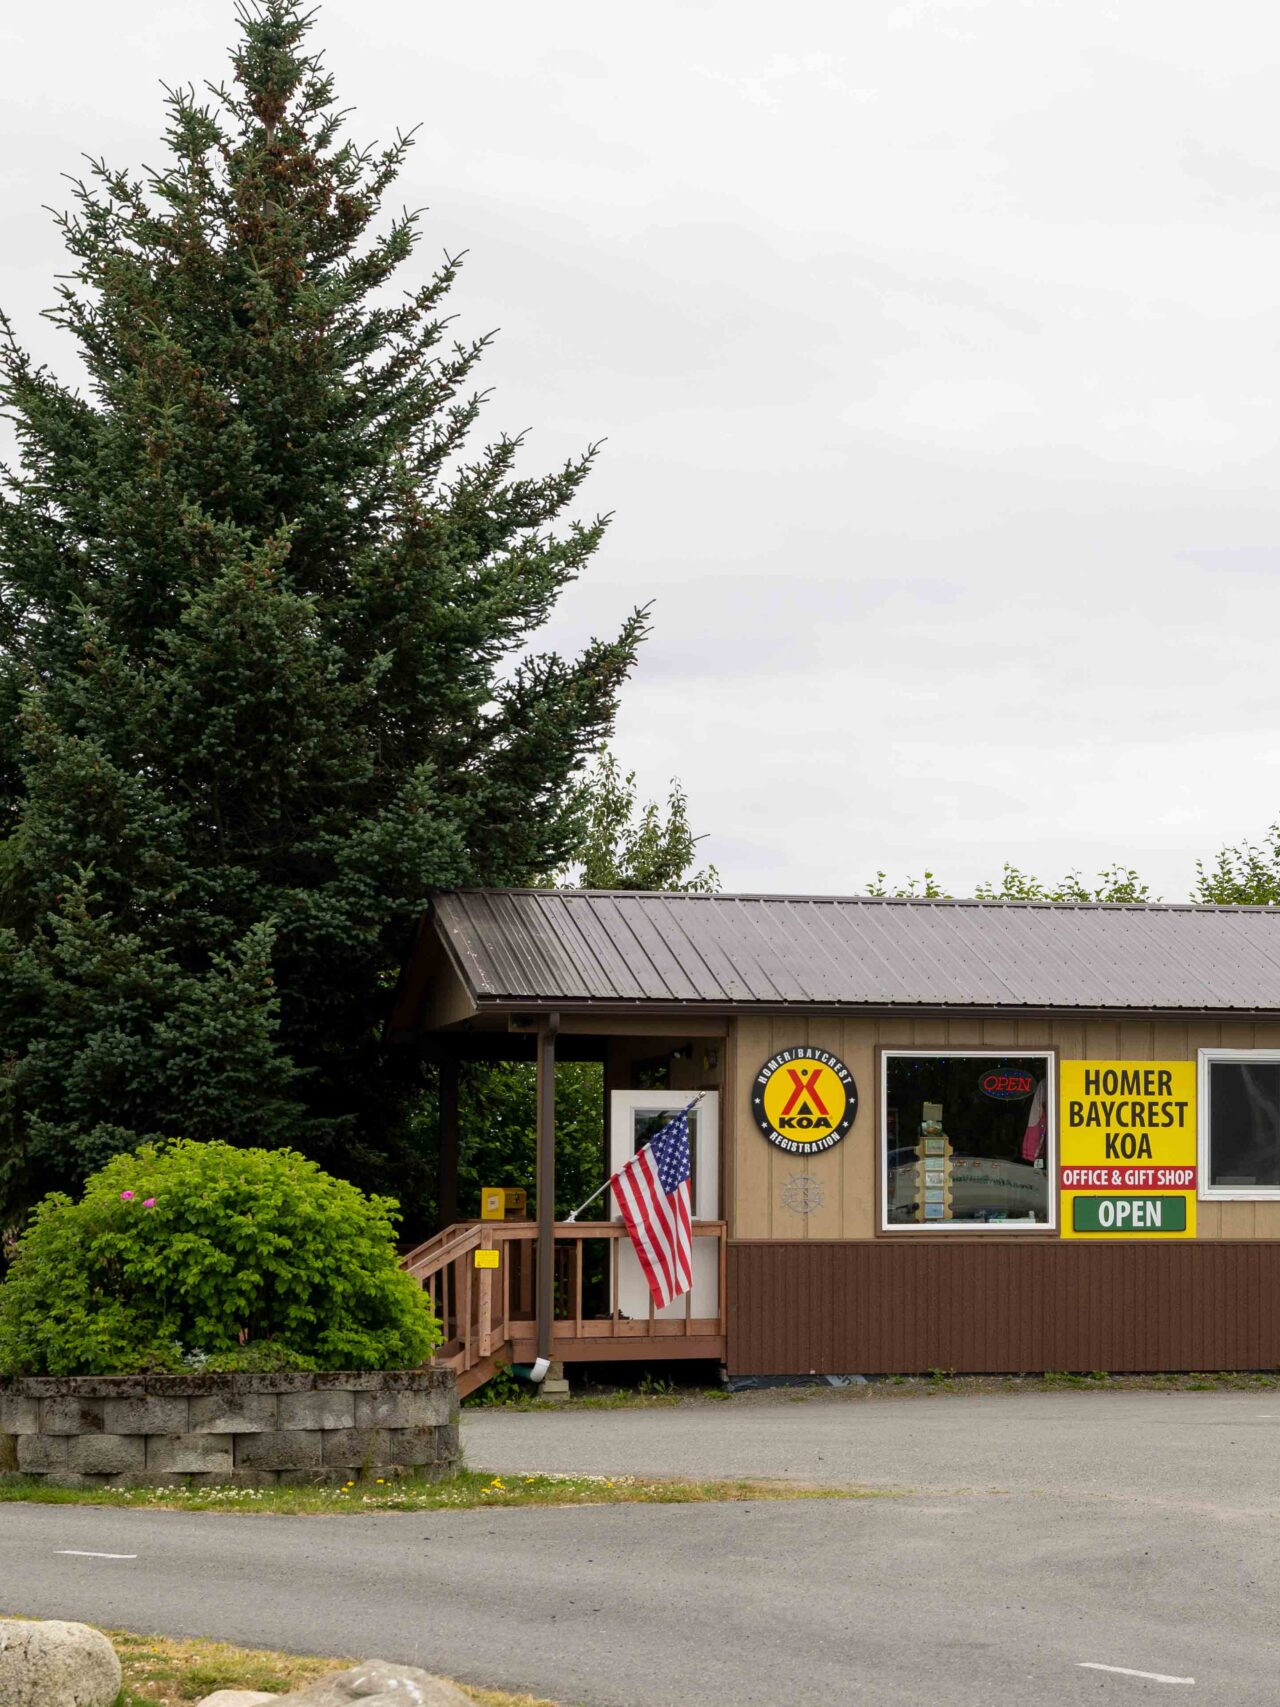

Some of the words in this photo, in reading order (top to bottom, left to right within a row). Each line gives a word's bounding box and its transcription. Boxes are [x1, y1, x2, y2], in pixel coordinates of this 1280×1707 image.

[758, 1048, 852, 1084] HOMER/BAYCREST
[983, 1075, 1032, 1093] OPEN
[1084, 1069, 1172, 1096] HOMER
[778, 1116, 833, 1129] KOA
[1069, 1101, 1188, 1128] BAYCREST
[769, 1131, 841, 1153] REGISTRATION
[1105, 1133, 1153, 1159] KOA
[1063, 1169, 1109, 1185] OFFICE
[1111, 1169, 1122, 1185] &
[1125, 1169, 1155, 1185] GIFT
[1157, 1169, 1194, 1185] SHOP
[1098, 1200, 1162, 1227] OPEN
